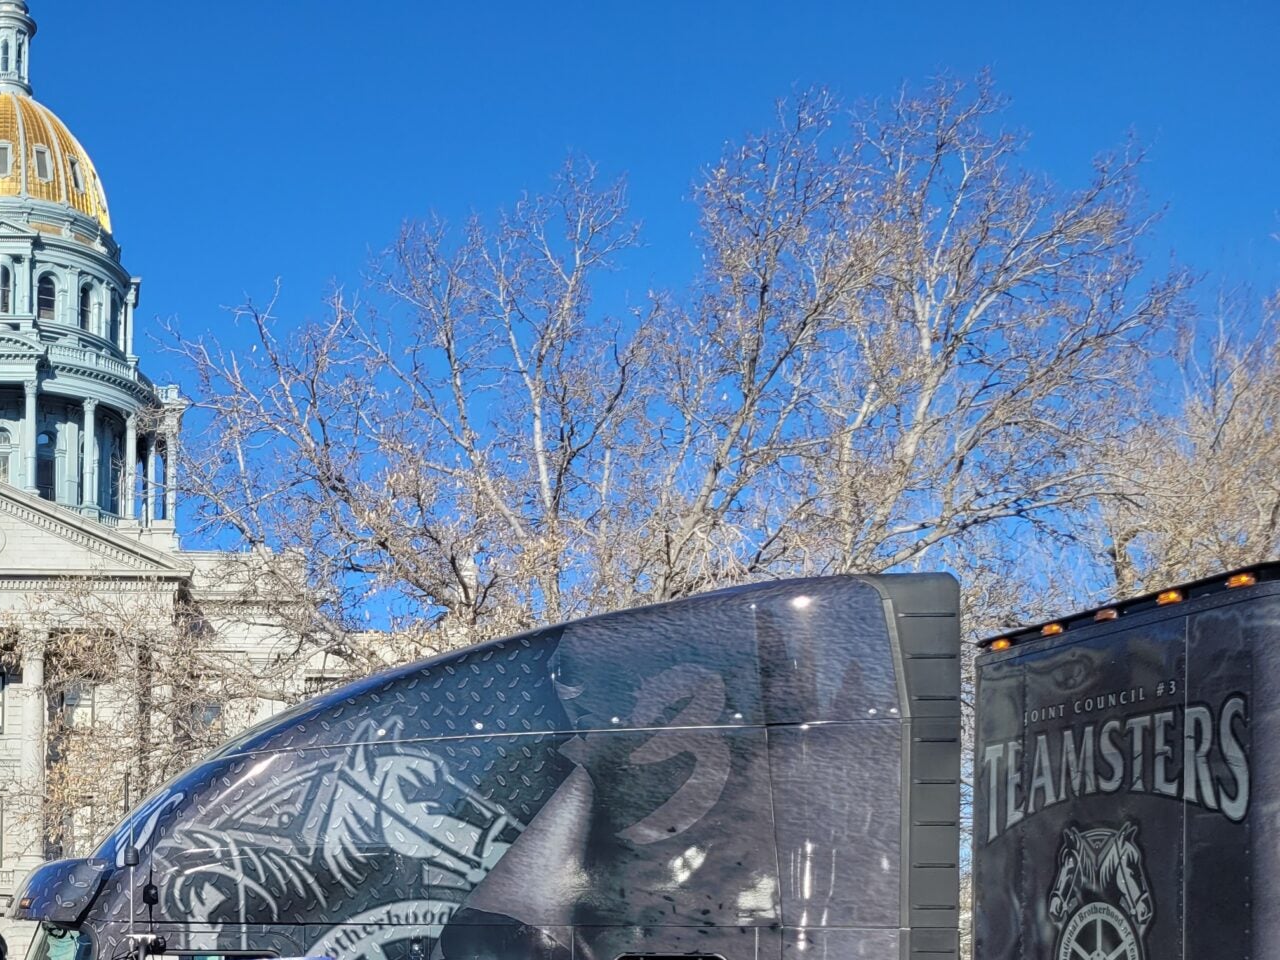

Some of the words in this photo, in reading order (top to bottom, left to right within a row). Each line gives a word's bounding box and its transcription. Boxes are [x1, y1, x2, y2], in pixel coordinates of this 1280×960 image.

[1024, 704, 1065, 726] JOINT
[1074, 687, 1145, 714] COUNCIL
[1156, 680, 1177, 696] #3
[984, 697, 1250, 844] TEAMSTERS
[324, 906, 458, 958] otherhood
[1078, 905, 1124, 927] Brotherhood
